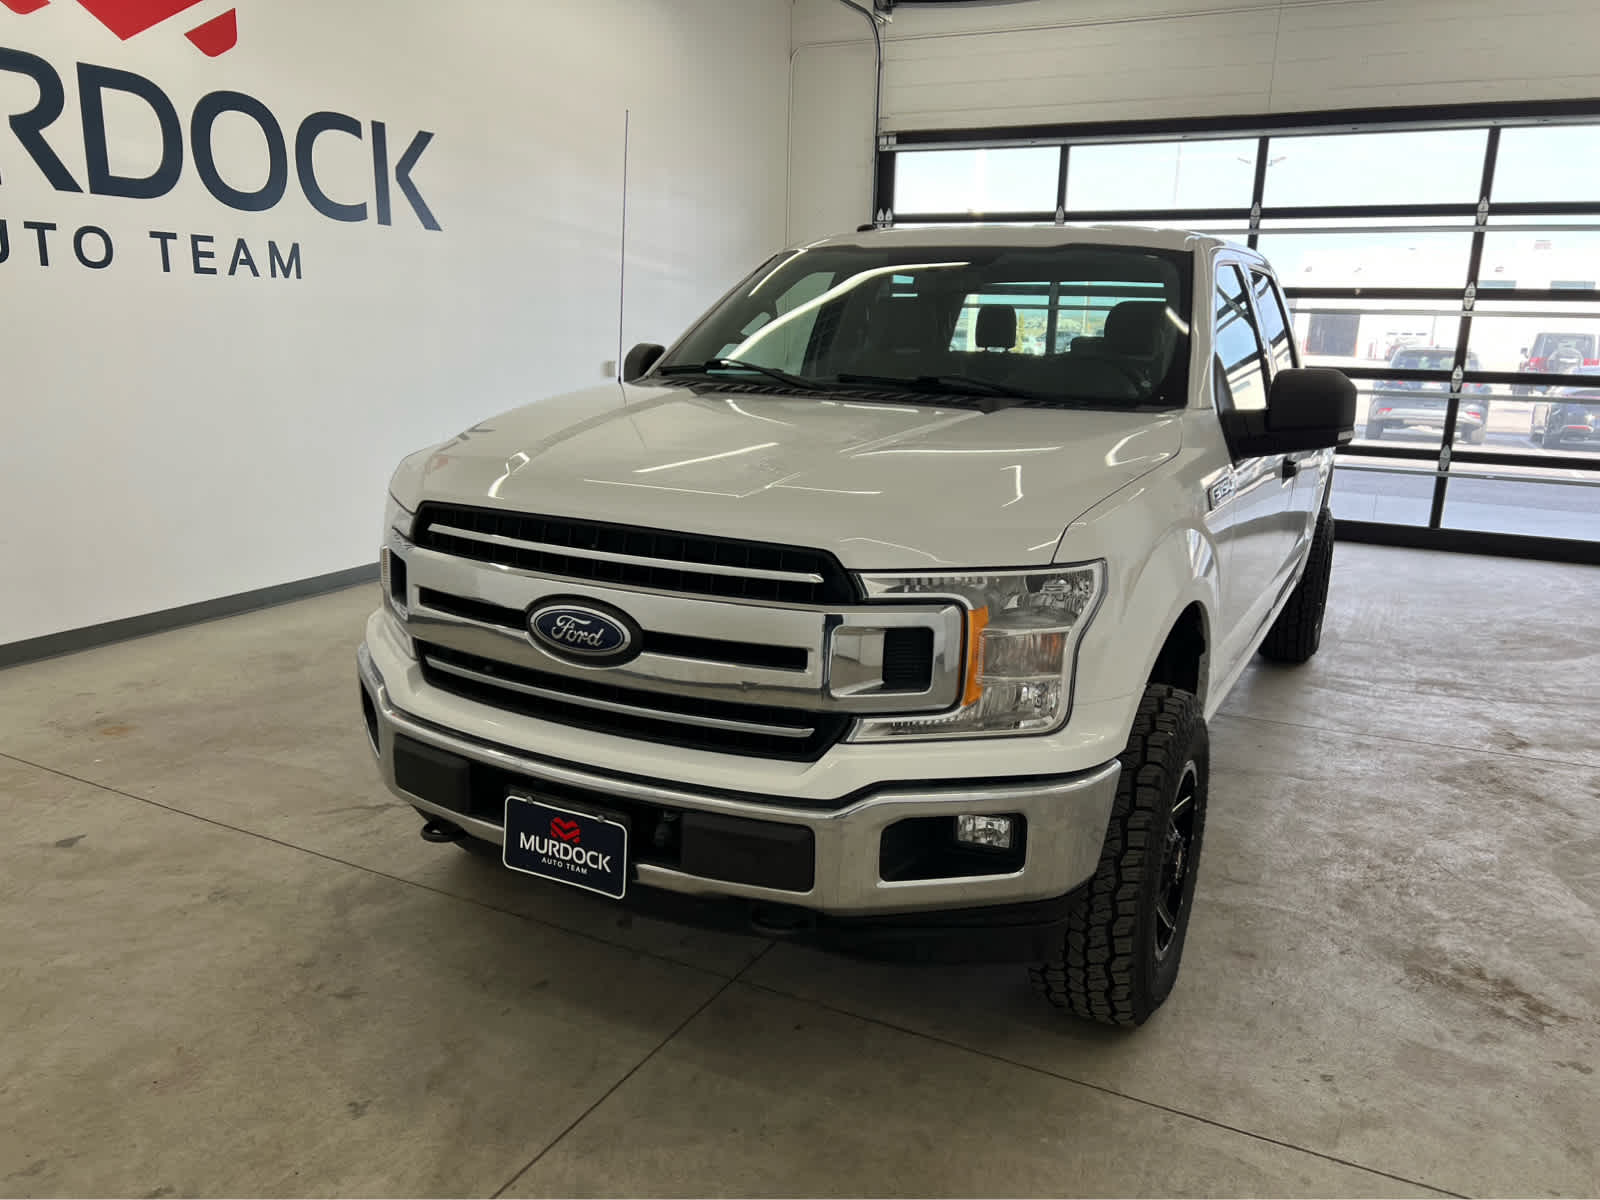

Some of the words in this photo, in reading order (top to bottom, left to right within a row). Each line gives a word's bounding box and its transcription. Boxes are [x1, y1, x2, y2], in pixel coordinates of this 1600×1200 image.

[149, 231, 303, 280] TEAM
[552, 615, 604, 647] Ford
[520, 832, 612, 873] MURDOCK
[541, 857, 563, 868] AUTO
[566, 864, 588, 874] TEAM
